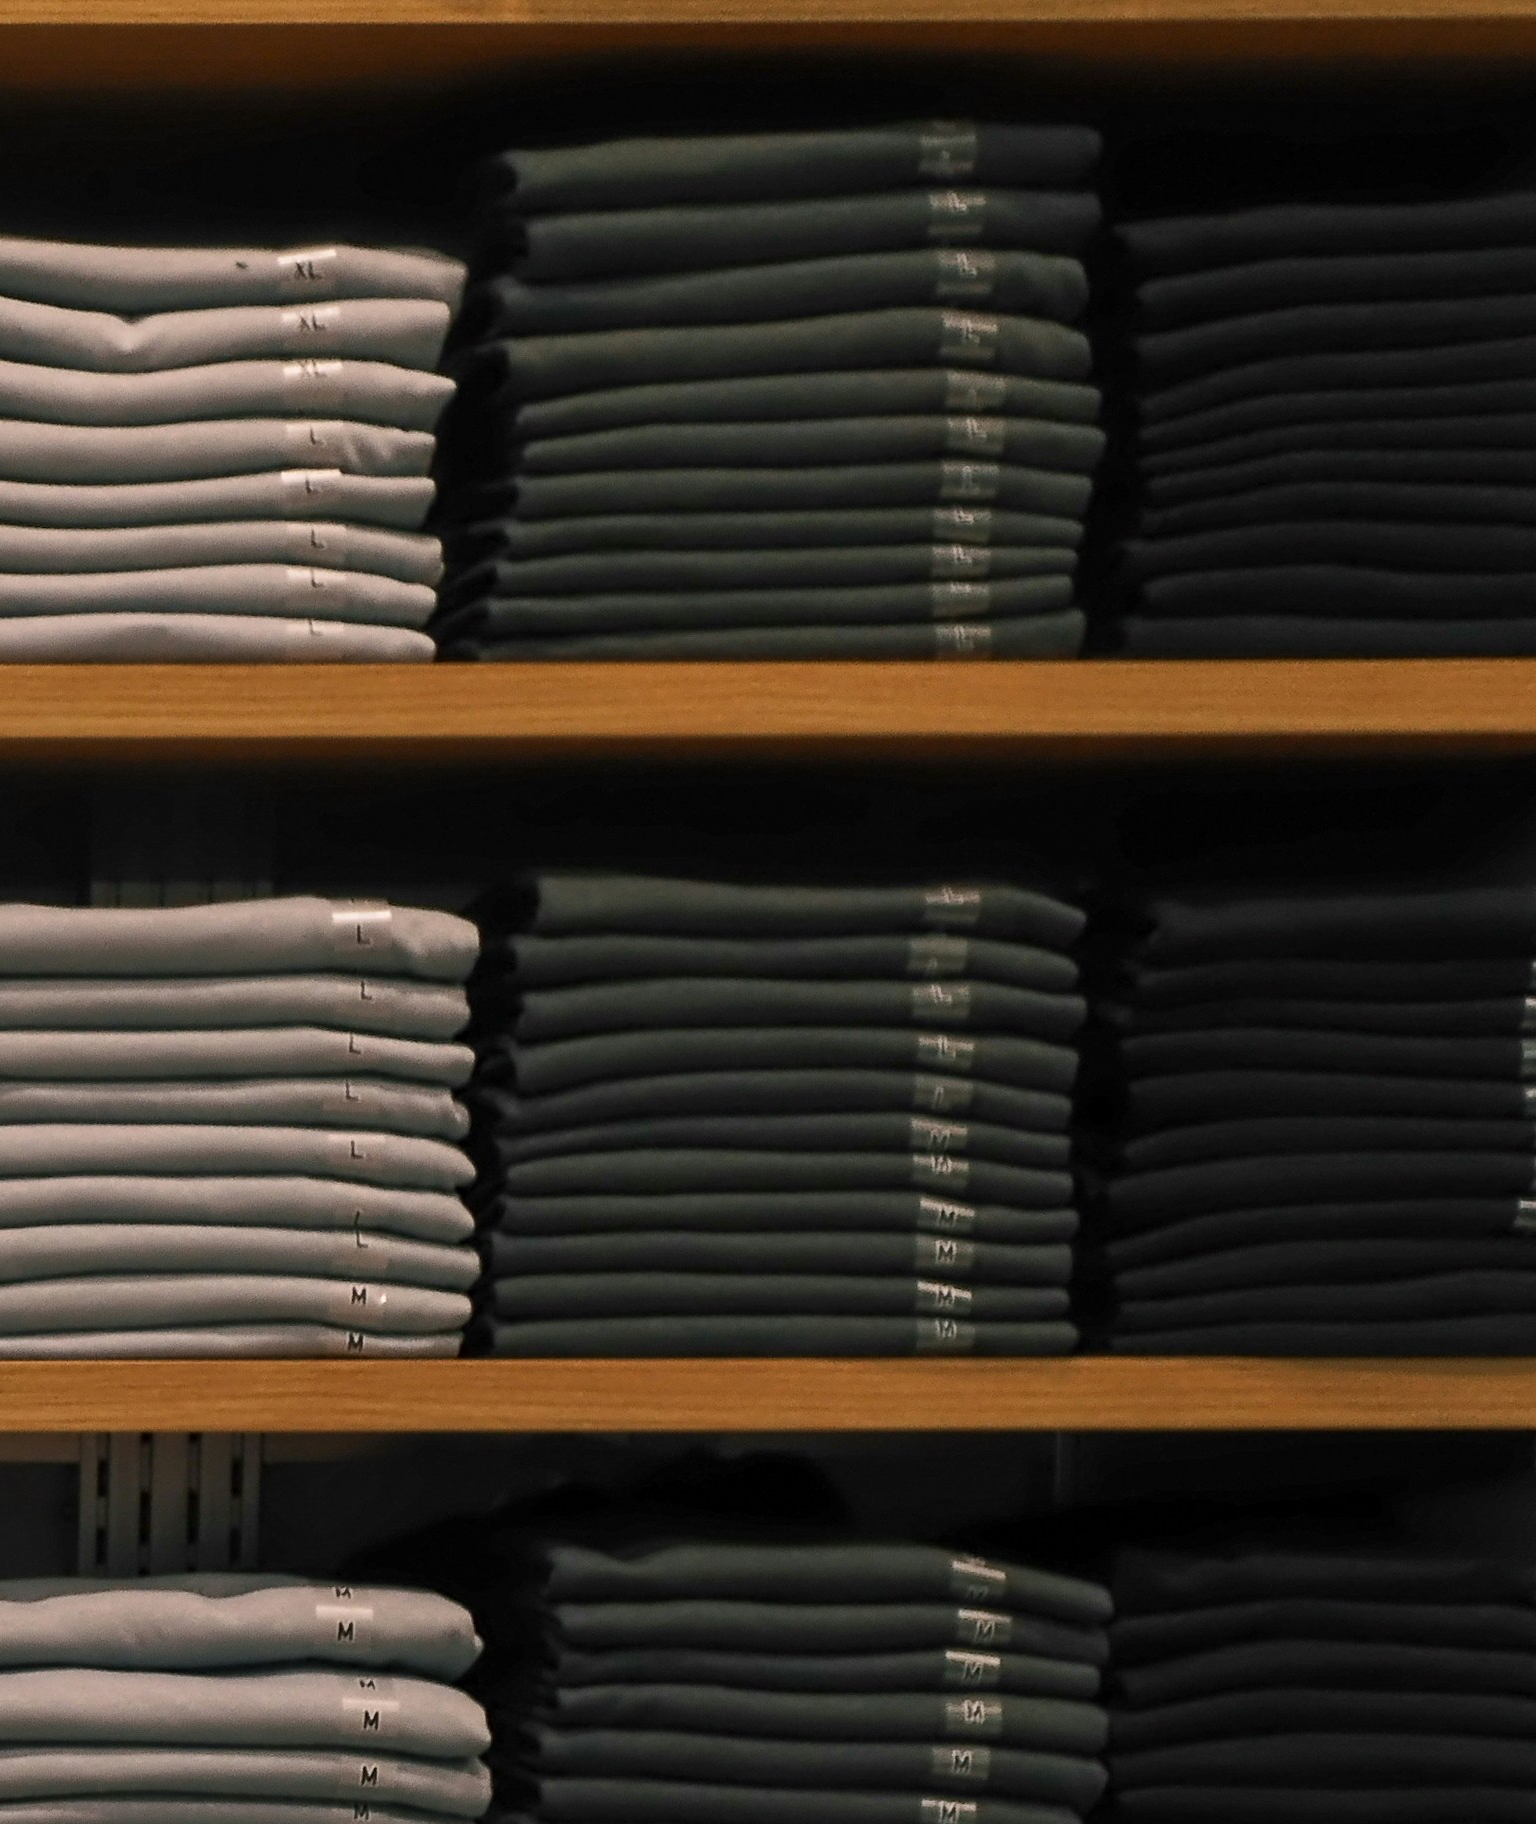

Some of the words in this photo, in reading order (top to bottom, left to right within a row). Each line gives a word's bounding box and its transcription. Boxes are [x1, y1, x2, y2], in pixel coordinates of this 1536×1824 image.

[294, 262, 322, 280] XL
[311, 530, 325, 548] L
[357, 925, 371, 944] L
[351, 1141, 363, 1159] L
[351, 1286, 366, 1304] M
[337, 1621, 354, 1641] M
[364, 1711, 379, 1730] M
[361, 1767, 377, 1786] M
